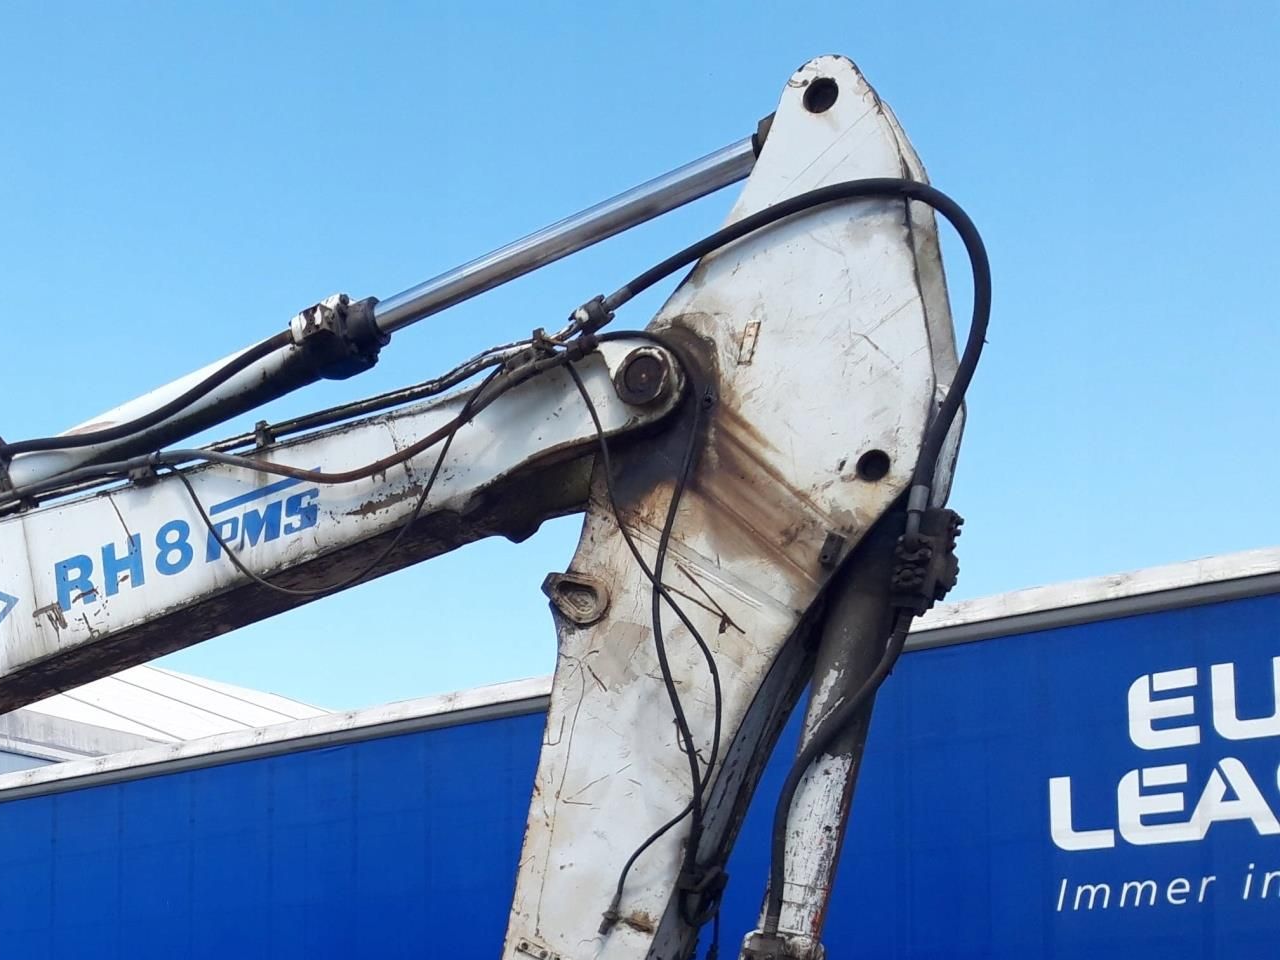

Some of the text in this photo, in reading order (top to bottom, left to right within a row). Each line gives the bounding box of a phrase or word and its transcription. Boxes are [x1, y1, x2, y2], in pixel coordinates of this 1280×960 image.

[206, 488, 319, 563] PMS
[1127, 656, 1280, 750] EU
[1049, 757, 1280, 850] LEA
[1056, 877, 1216, 911] Immer
